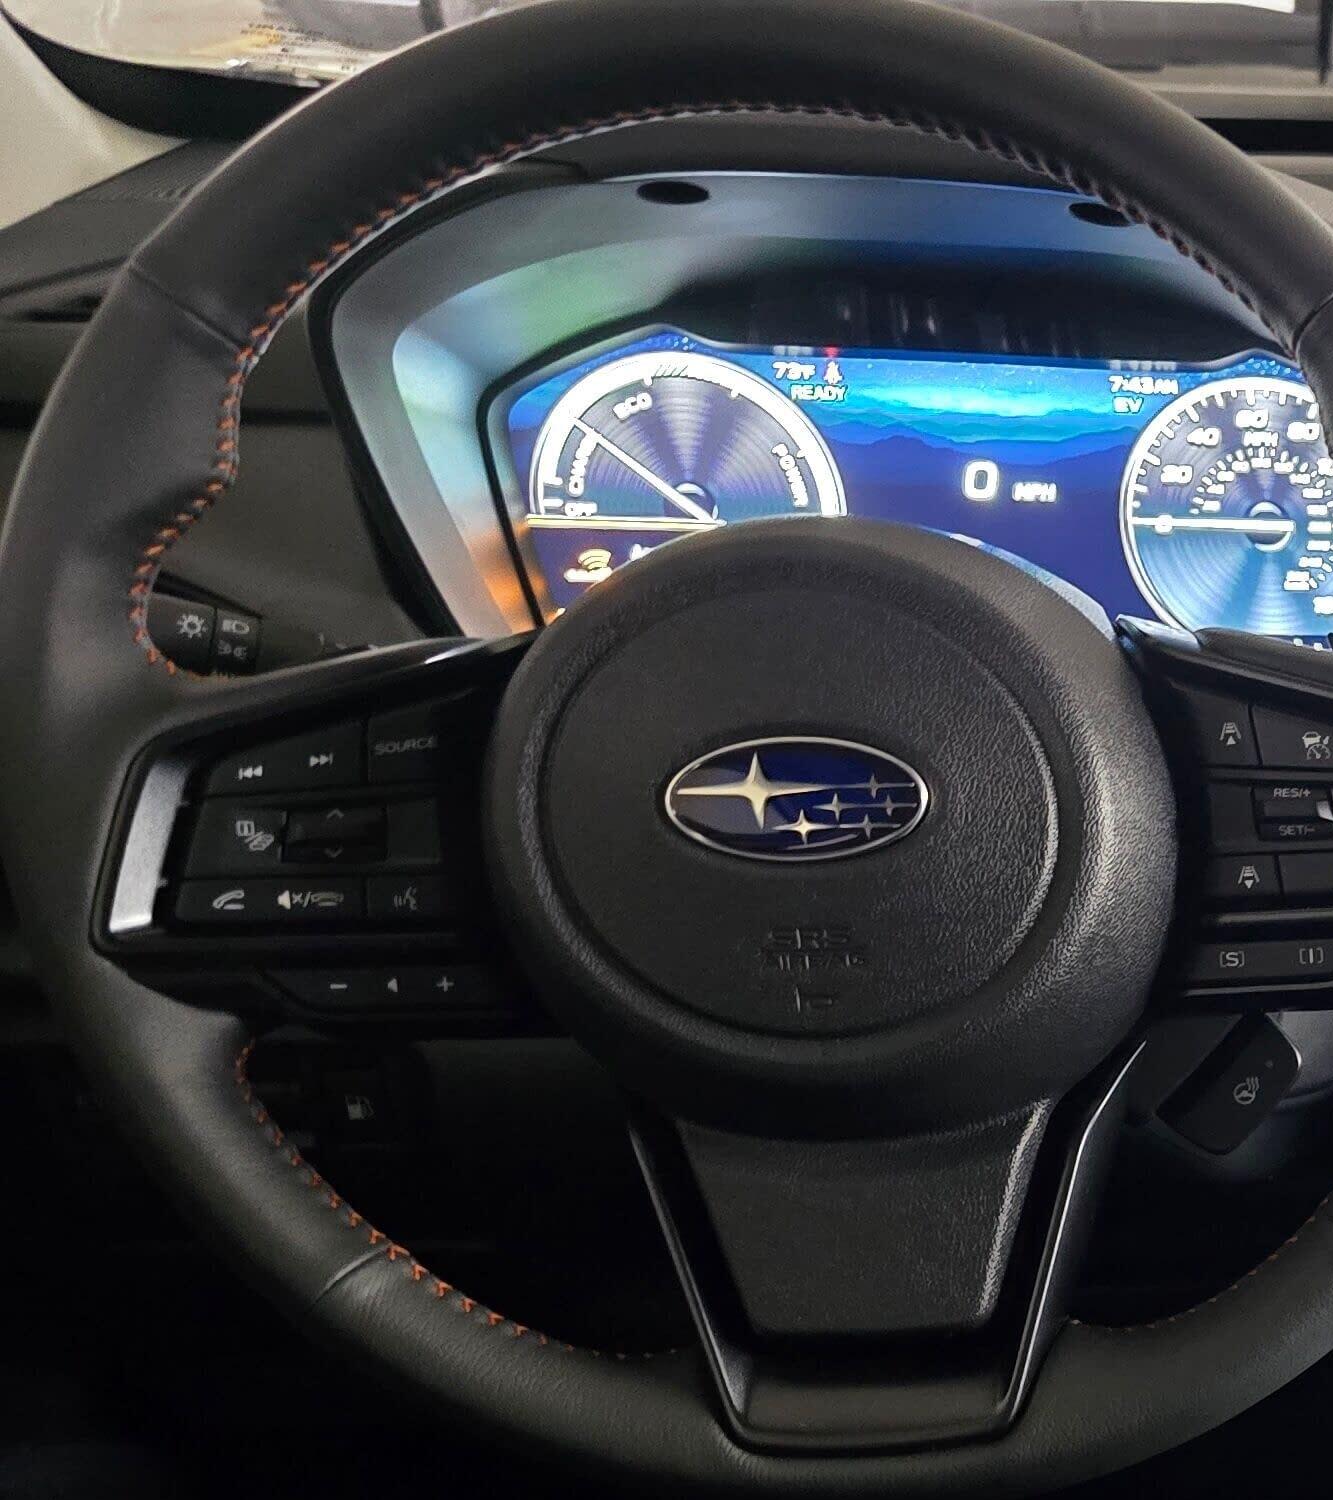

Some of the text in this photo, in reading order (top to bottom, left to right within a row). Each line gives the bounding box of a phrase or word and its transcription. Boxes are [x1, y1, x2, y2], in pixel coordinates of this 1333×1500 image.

[790, 385, 849, 402] READY
[612, 392, 652, 421] ECO
[1113, 397, 1144, 413] EV
[1186, 427, 1222, 446] 40
[962, 460, 1057, 502] 0 MPH
[375, 735, 438, 756] SOURCE
